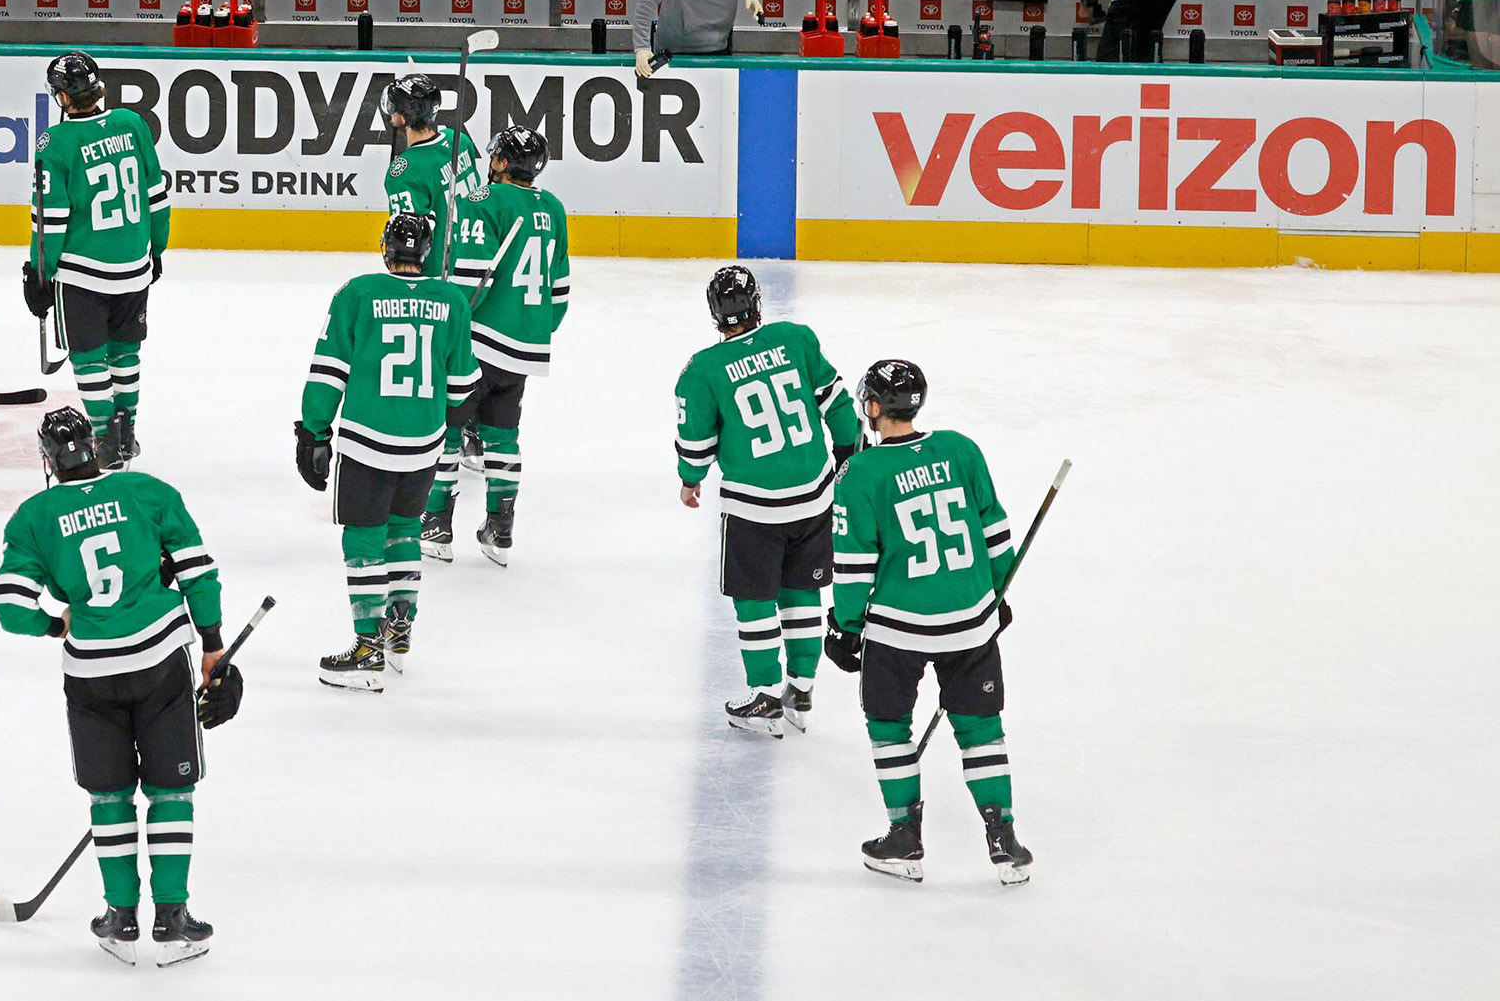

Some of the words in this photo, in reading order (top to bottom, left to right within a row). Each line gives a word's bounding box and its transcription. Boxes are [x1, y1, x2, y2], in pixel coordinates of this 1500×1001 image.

[100, 67, 705, 164] BODYARMOR
[80, 132, 136, 164] PETROVIC
[872, 83, 1458, 217] verizon
[85, 155, 142, 232] 28
[162, 170, 240, 195] ORTS
[252, 171, 359, 197] DRINK
[388, 191, 415, 218] 53
[406, 238, 415, 248] 21
[460, 217, 486, 245] 44
[372, 299, 451, 323] ROBERTSON
[727, 316, 738, 325] 95
[380, 323, 435, 399] 21
[725, 346, 791, 384] DUCHENE
[733, 369, 814, 459] 95
[910, 392, 921, 405] 55
[67, 441, 76, 452] 6
[894, 460, 953, 495] HARLEY
[58, 501, 128, 538] BICHSEL
[894, 487, 974, 580] 55
[79, 531, 124, 608] 6
